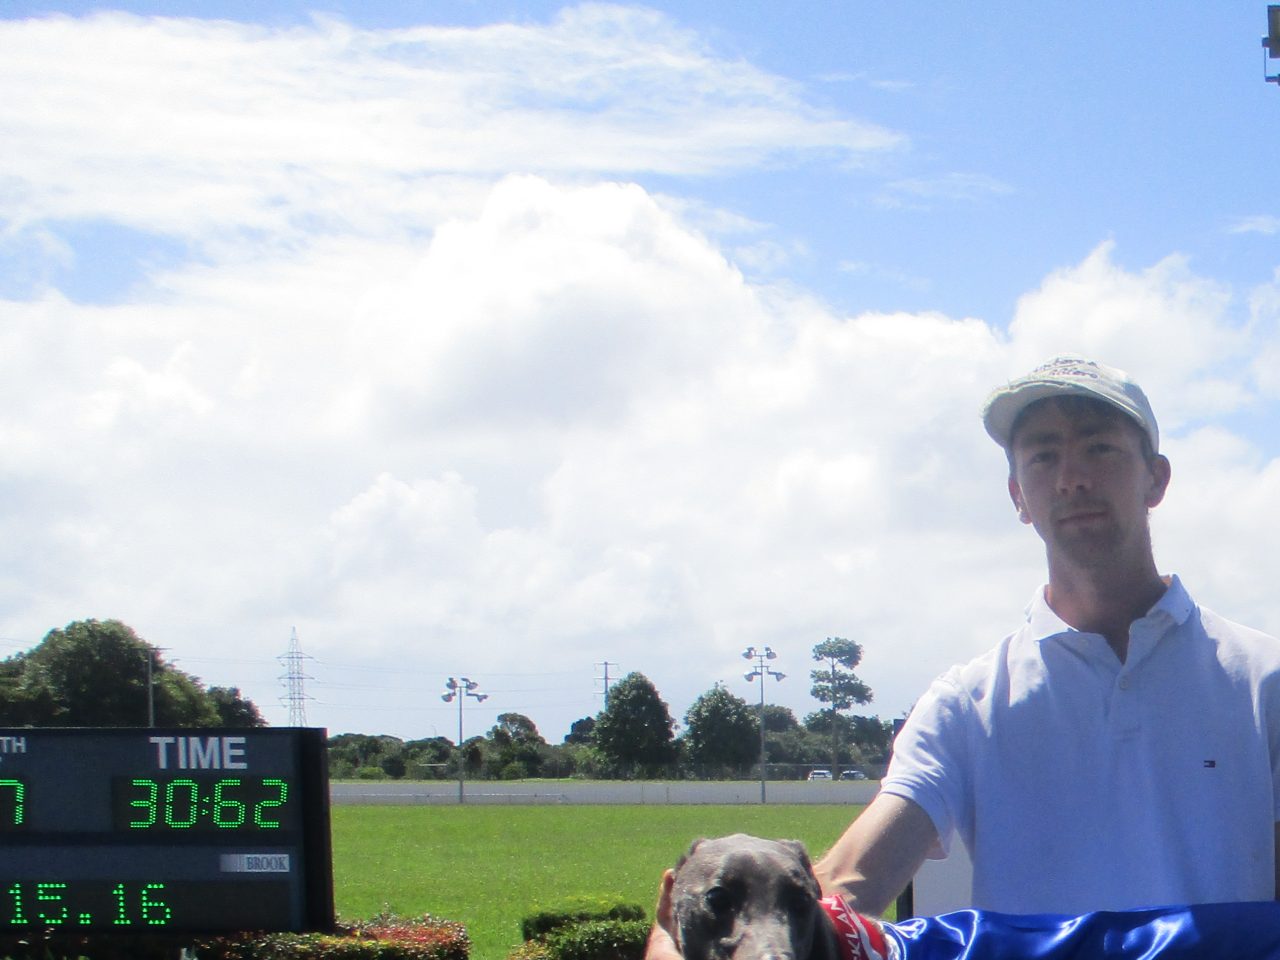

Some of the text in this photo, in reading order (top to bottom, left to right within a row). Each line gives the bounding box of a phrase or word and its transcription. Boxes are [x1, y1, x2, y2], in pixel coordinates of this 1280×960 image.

[149, 736, 248, 769] TIME
[0, 779, 25, 825] 7
[129, 779, 288, 828] 30:62
[8, 883, 172, 925] 15.16
